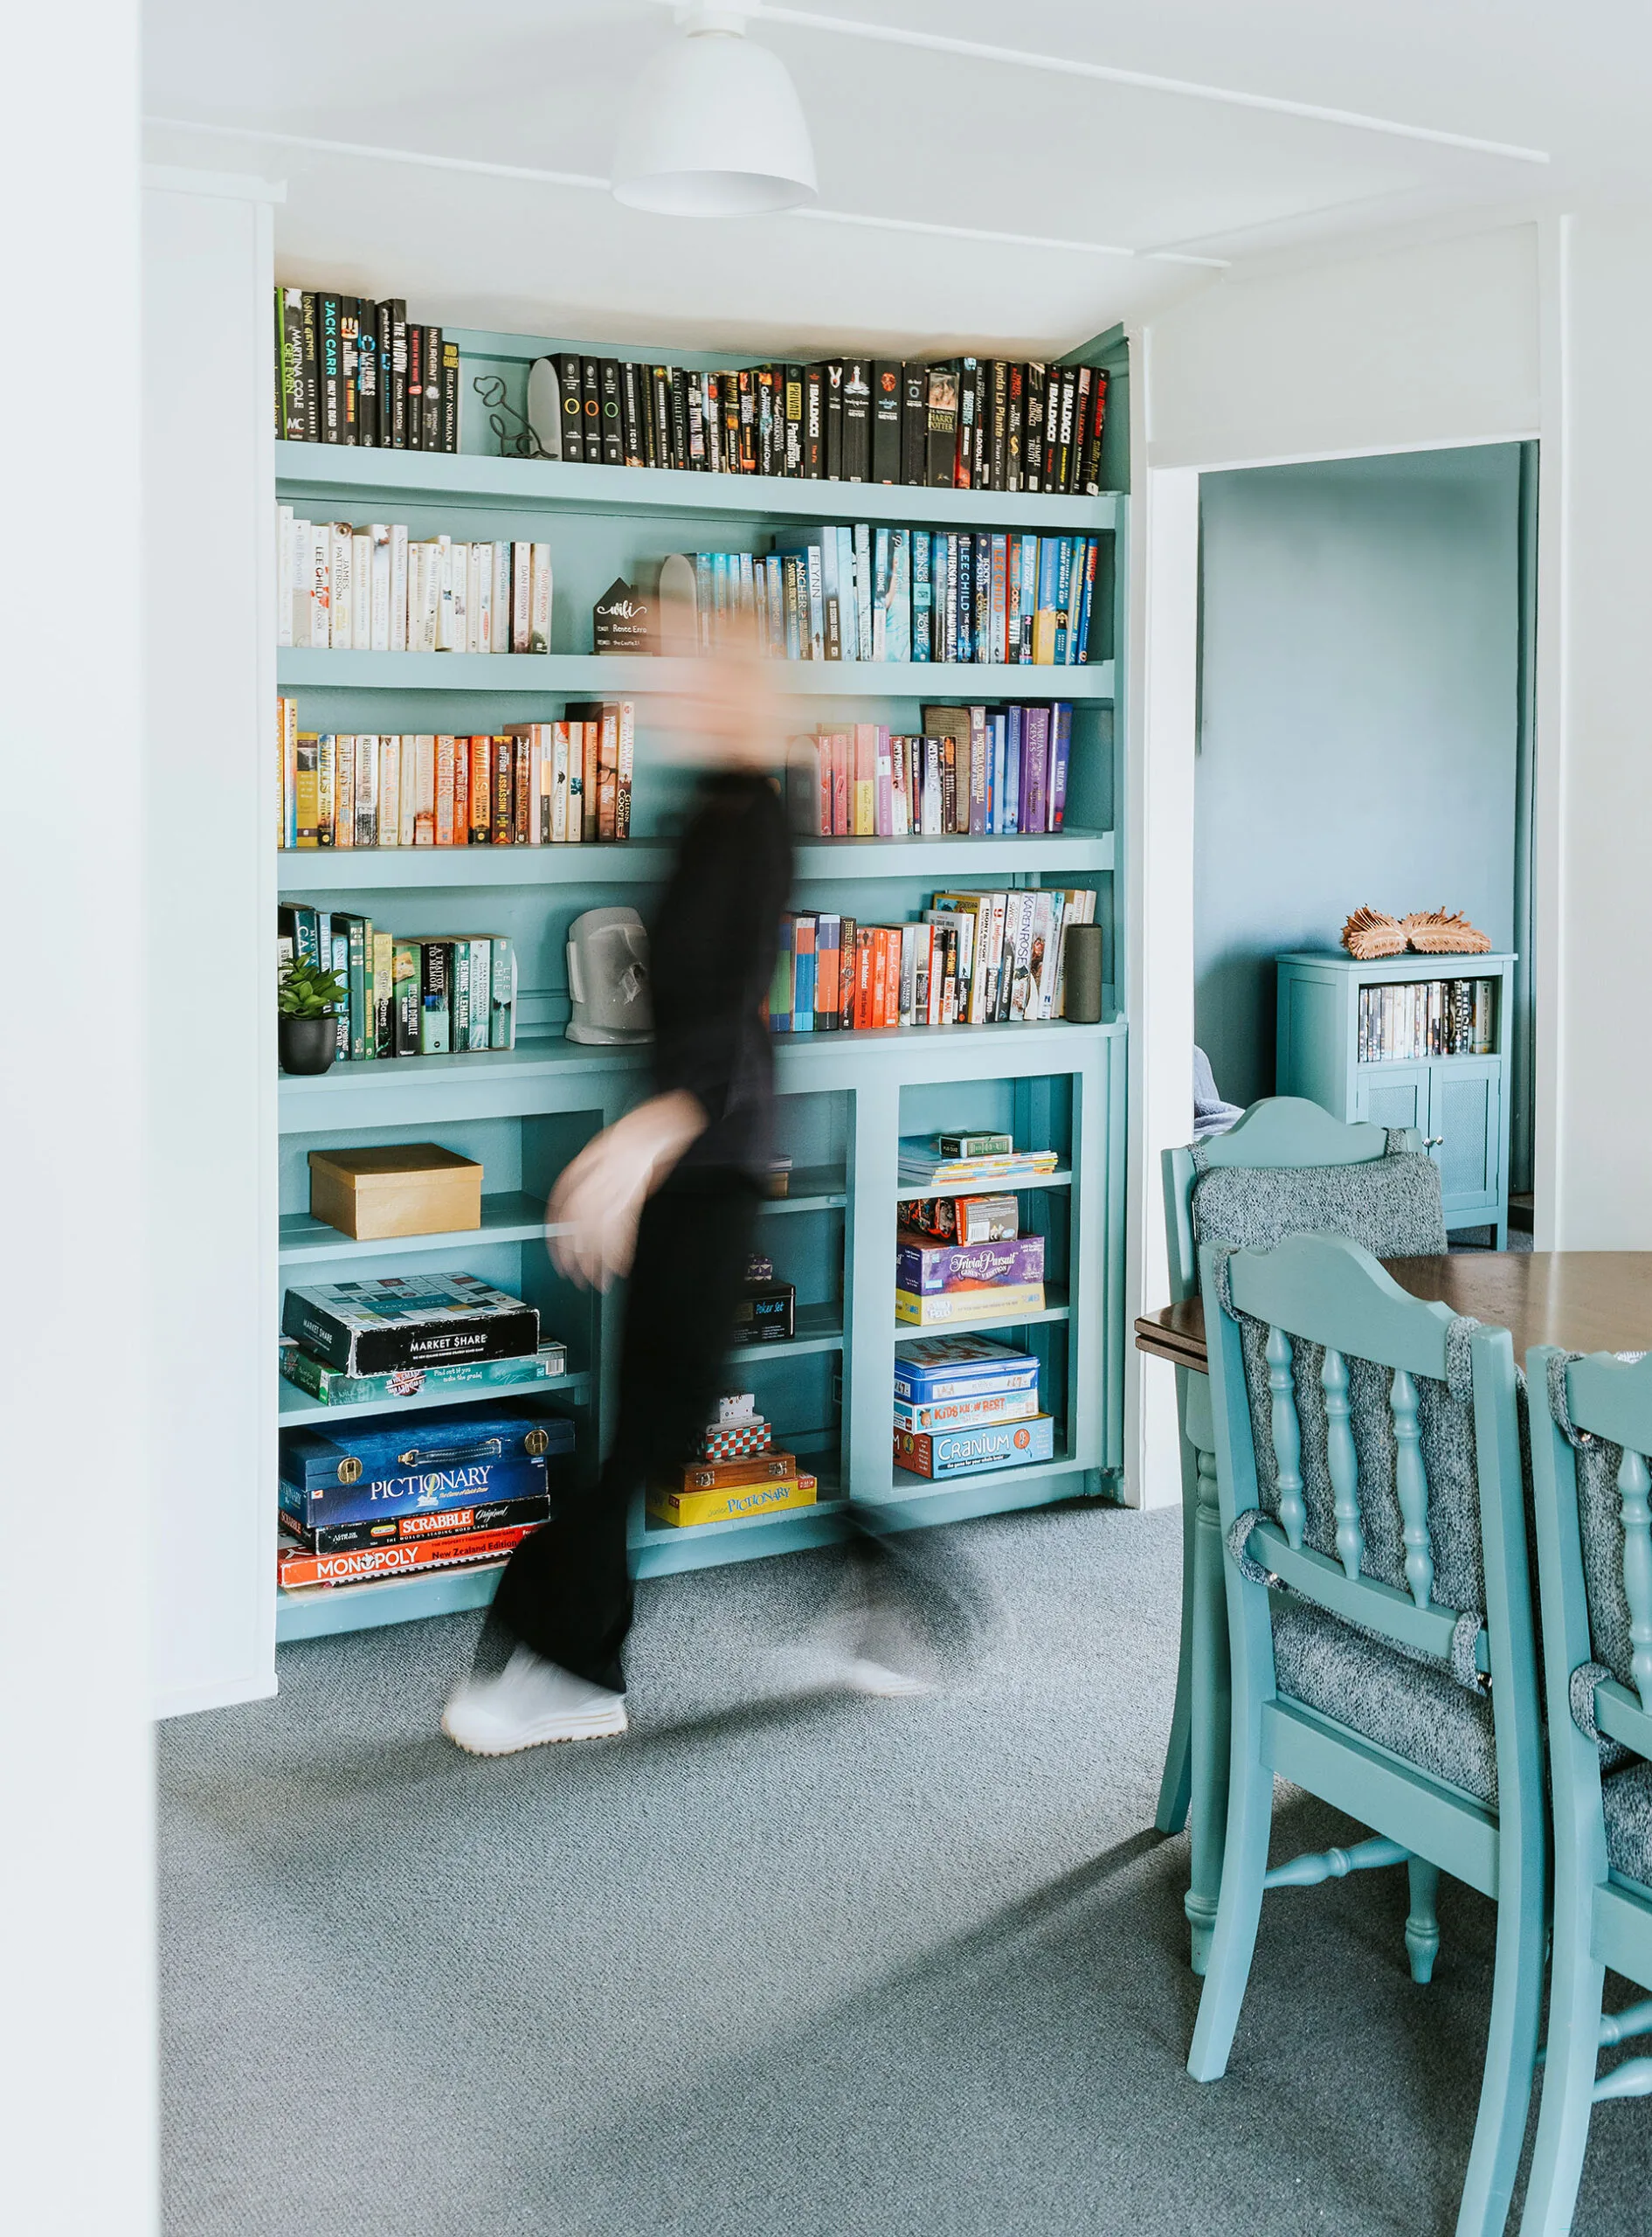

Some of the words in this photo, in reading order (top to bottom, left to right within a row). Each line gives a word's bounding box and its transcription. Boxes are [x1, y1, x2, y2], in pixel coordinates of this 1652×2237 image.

[325, 301, 336, 335] JACK
[393, 322, 404, 336] THE
[285, 343, 294, 365] GET
[293, 329, 302, 377] MARTINA
[326, 339, 337, 375] CARR
[393, 339, 407, 373] WIDOW
[428, 329, 438, 381] INSURGENT
[327, 379, 337, 396] ONLY
[446, 369, 454, 400] HILARY
[994, 363, 1006, 389] Lynda
[1098, 379, 1107, 397] Alex
[294, 379, 304, 408] COLE
[328, 398, 336, 408] THE
[674, 391, 682, 424] FOLLETT
[789, 384, 799, 418] PRIVATE
[995, 392, 1005, 404] La
[328, 409, 337, 426] DEAD
[446, 402, 454, 442] NORMAN
[690, 407, 702, 433] RITUAL
[810, 387, 819, 438] BALDACCI
[929, 412, 953, 424] HARRY
[995, 406, 1006, 437] Plante
[1028, 397, 1037, 426] BALDACCI
[1047, 388, 1058, 442] BALDACCI
[1060, 390, 1073, 444] BALDACCI
[787, 422, 798, 468] Patterson
[315, 546, 324, 565] LEE
[960, 547, 970, 570] LEE
[994, 549, 1004, 572] LEE
[315, 567, 324, 599] CHILD
[787, 563, 797, 586] SANDRA
[796, 560, 807, 608] ARCHER
[812, 554, 820, 599] FLYNN
[788, 587, 797, 612] BROWN
[960, 572, 970, 610] CHILD
[994, 573, 1004, 613] CHILD
[597, 599, 646, 620] wifi
[1009, 619, 1020, 644] WIN
[1028, 723, 1037, 752] KEYES
[320, 747, 331, 793] MILLS
[363, 738, 371, 784] RESURRECTION
[439, 737, 453, 796] ARCHER
[474, 745, 488, 791] MILLS
[518, 778, 528, 800] BURN
[976, 765, 985, 804] CORNWELL
[1055, 760, 1066, 792] WARLOCK
[498, 774, 507, 812] ASSASSINI
[518, 801, 528, 831] FACTOR
[1007, 901, 1016, 929] SWORD
[1021, 895, 1033, 932] KAREN
[844, 920, 854, 945] JEFFREY
[321, 949, 329, 959] LE
[429, 945, 436, 957] TO
[1017, 932, 1032, 965] ROSE
[435, 955, 444, 989] TRAITOR
[460, 959, 468, 993] DENNIS
[494, 960, 503, 999] CHILD
[408, 983, 418, 1008] NELSON
[986, 969, 998, 1013] Patterson
[408, 1009, 418, 1035] DEMILLE
[460, 995, 468, 1028] LEHANE
[950, 1253, 982, 1272] Trivial
[979, 1250, 1015, 1273] Pursuit
[756, 1301, 773, 1315] Poker
[774, 1301, 785, 1312] Set
[303, 1319, 320, 1334] MARKET
[410, 1339, 451, 1353] MARKET
[982, 1397, 1006, 1411] BEST
[370, 1465, 493, 1500] PICTIONARY
[727, 1486, 791, 1513] PICTIONARY
[281, 1510, 302, 1534] SCRABBLE
[403, 1510, 473, 1534] SCRABBLE
[474, 1506, 509, 1522] Original
[399, 1533, 425, 1541] WORLD'S
[427, 1529, 453, 1538] LEADING
[432, 1550, 452, 1560] New
[453, 1544, 486, 1556] Zealand
[488, 1539, 517, 1551] Edition
[316, 1547, 419, 1579] MONOPOLY
